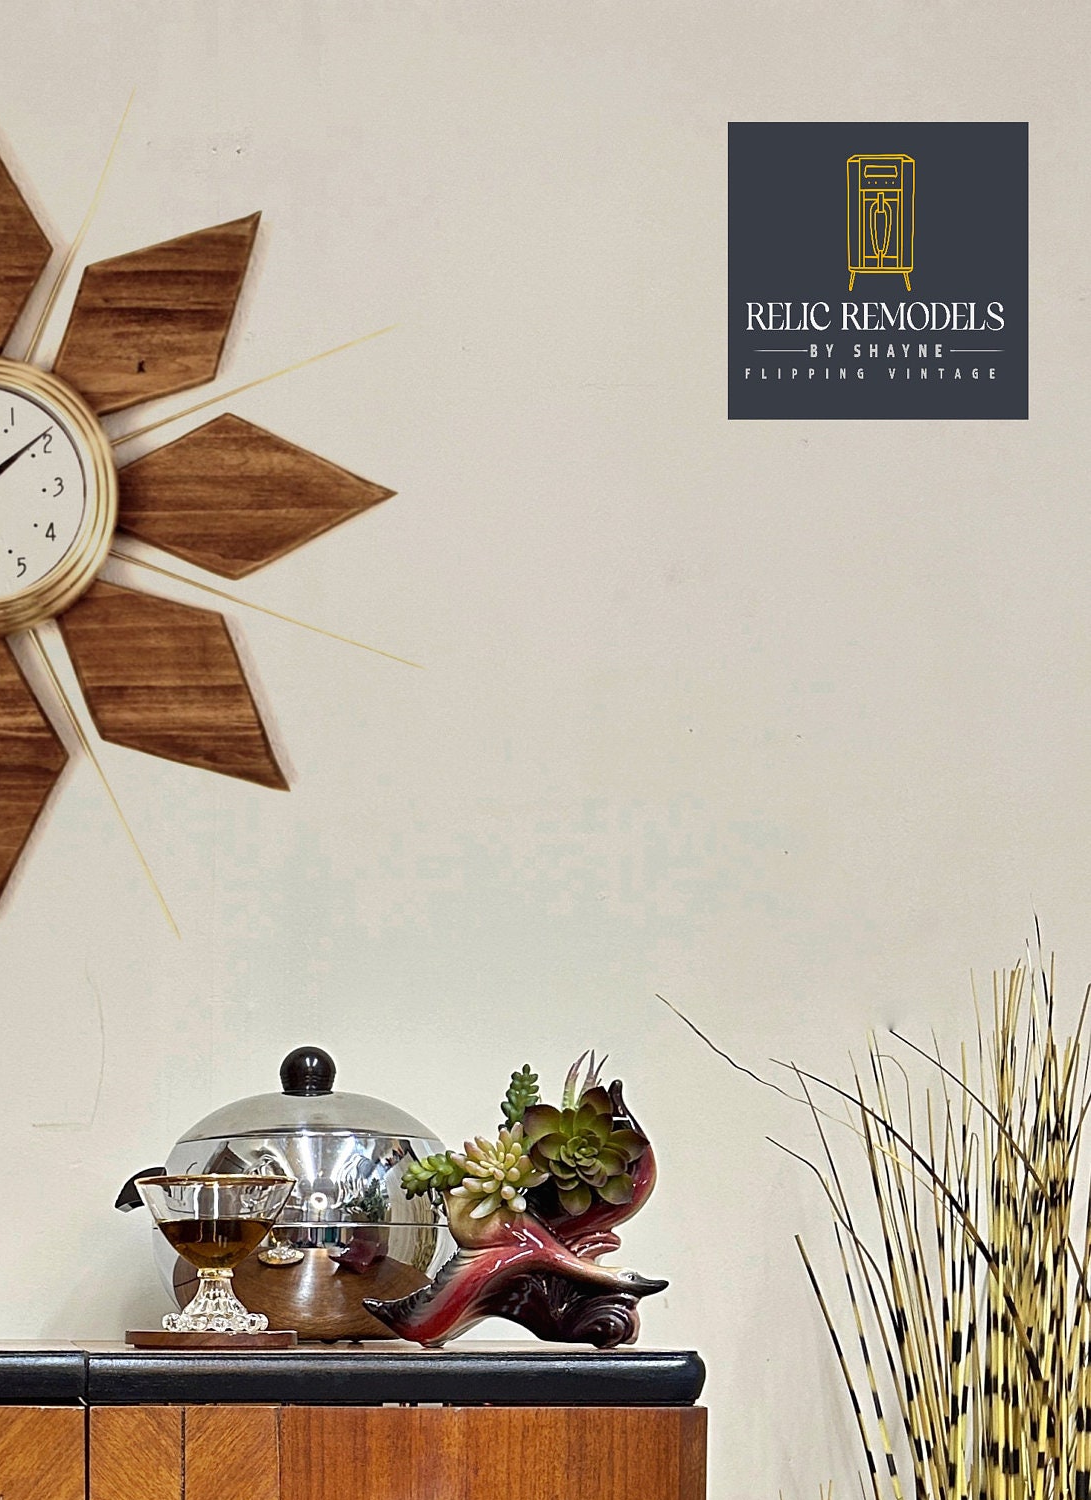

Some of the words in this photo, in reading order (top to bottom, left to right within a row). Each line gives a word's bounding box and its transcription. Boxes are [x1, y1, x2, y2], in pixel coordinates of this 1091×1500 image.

[42, 433, 53, 454] 2
[53, 477, 65, 497] 3
[45, 522, 57, 541] 4
[16, 557, 27, 577] 5
